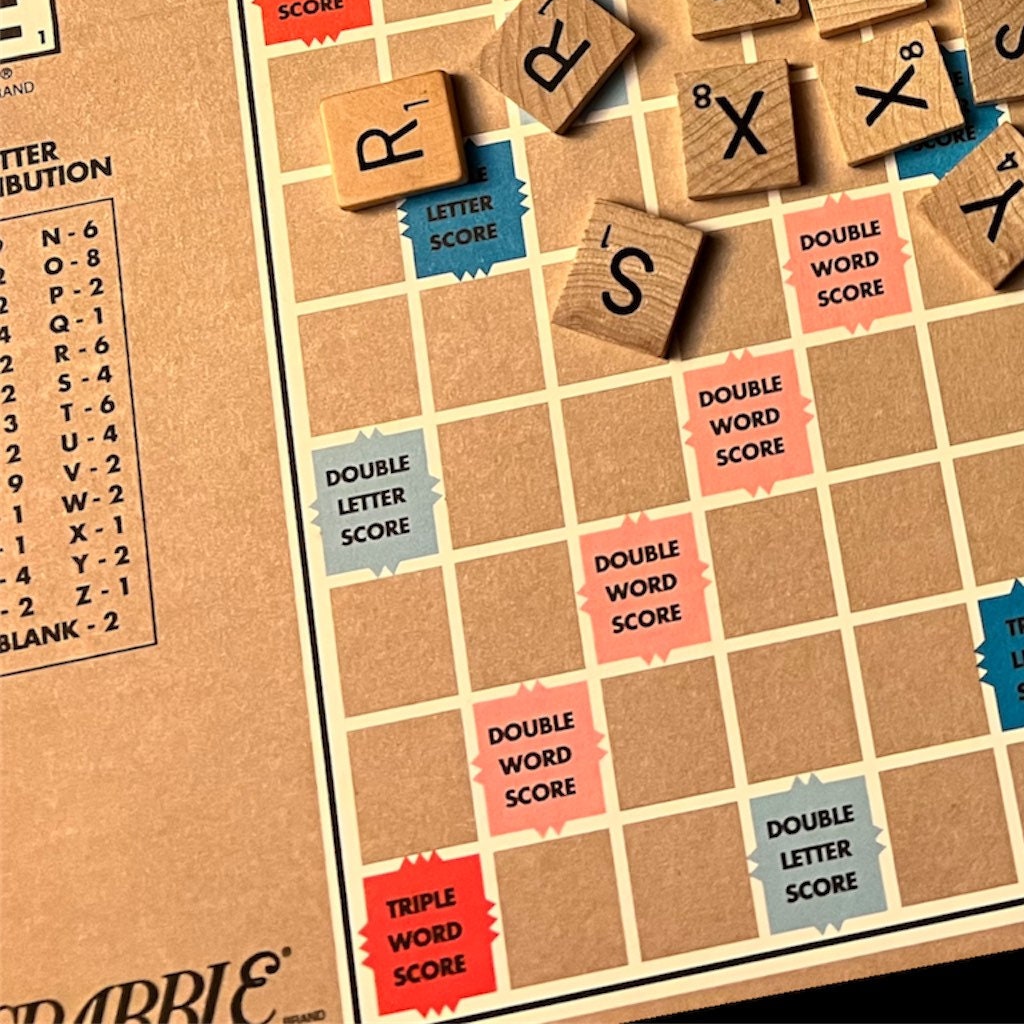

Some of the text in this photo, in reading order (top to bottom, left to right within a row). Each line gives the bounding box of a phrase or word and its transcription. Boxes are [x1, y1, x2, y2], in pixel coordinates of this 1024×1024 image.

[426, 194, 494, 223] LETTER
[430, 223, 498, 252] SCORE
[800, 220, 881, 251] DOUBLE
[810, 250, 879, 278] WORD
[817, 278, 885, 308] SCORE
[325, 454, 410, 487] DOUBLE
[337, 487, 406, 516] LETTER
[341, 517, 410, 546] SCORE
[594, 539, 680, 573] DOUBLE
[605, 573, 678, 602] WORD
[611, 603, 682, 634] SCORE
[766, 804, 855, 839] DOUBLE
[780, 839, 853, 870] LETTER
[385, 887, 457, 919] TRIPLE
[785, 871, 859, 904] SCORE
[387, 921, 463, 953] WORD
[393, 954, 466, 987] SCORE
